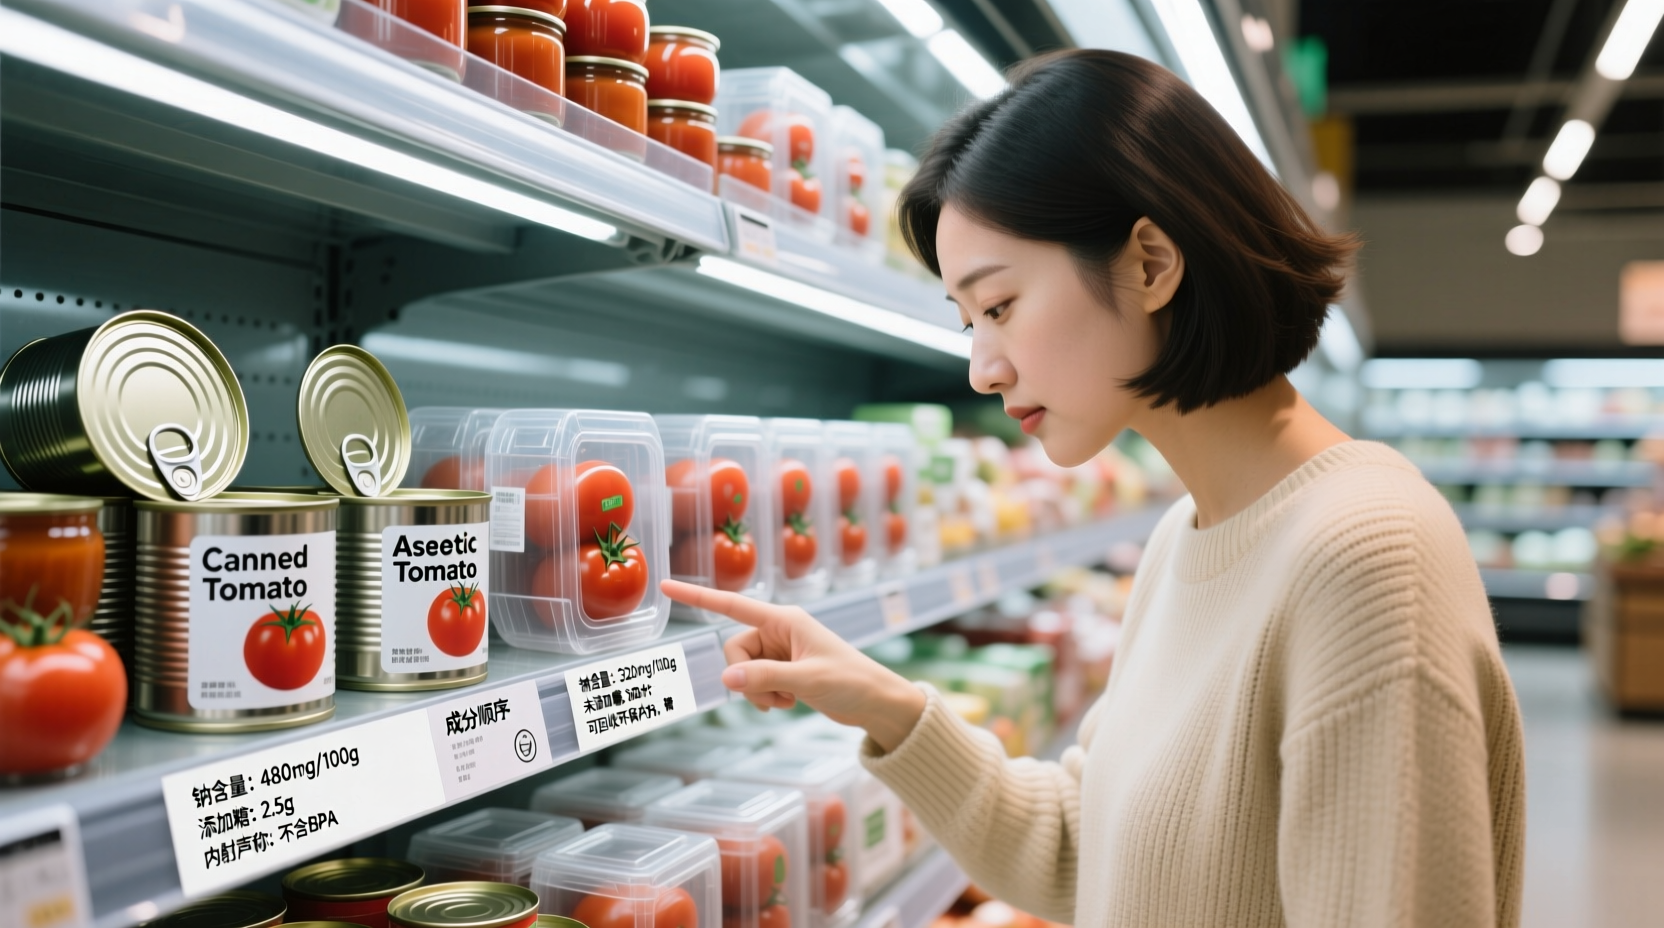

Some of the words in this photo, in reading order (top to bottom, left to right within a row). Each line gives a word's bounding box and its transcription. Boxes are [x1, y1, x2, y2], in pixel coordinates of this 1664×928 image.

[392, 531, 477, 557] Aseetic
[202, 544, 308, 572] Canned
[392, 560, 477, 582] Tomato
[202, 576, 307, 601] Tomato
[445, 697, 511, 736] 成分顺序
